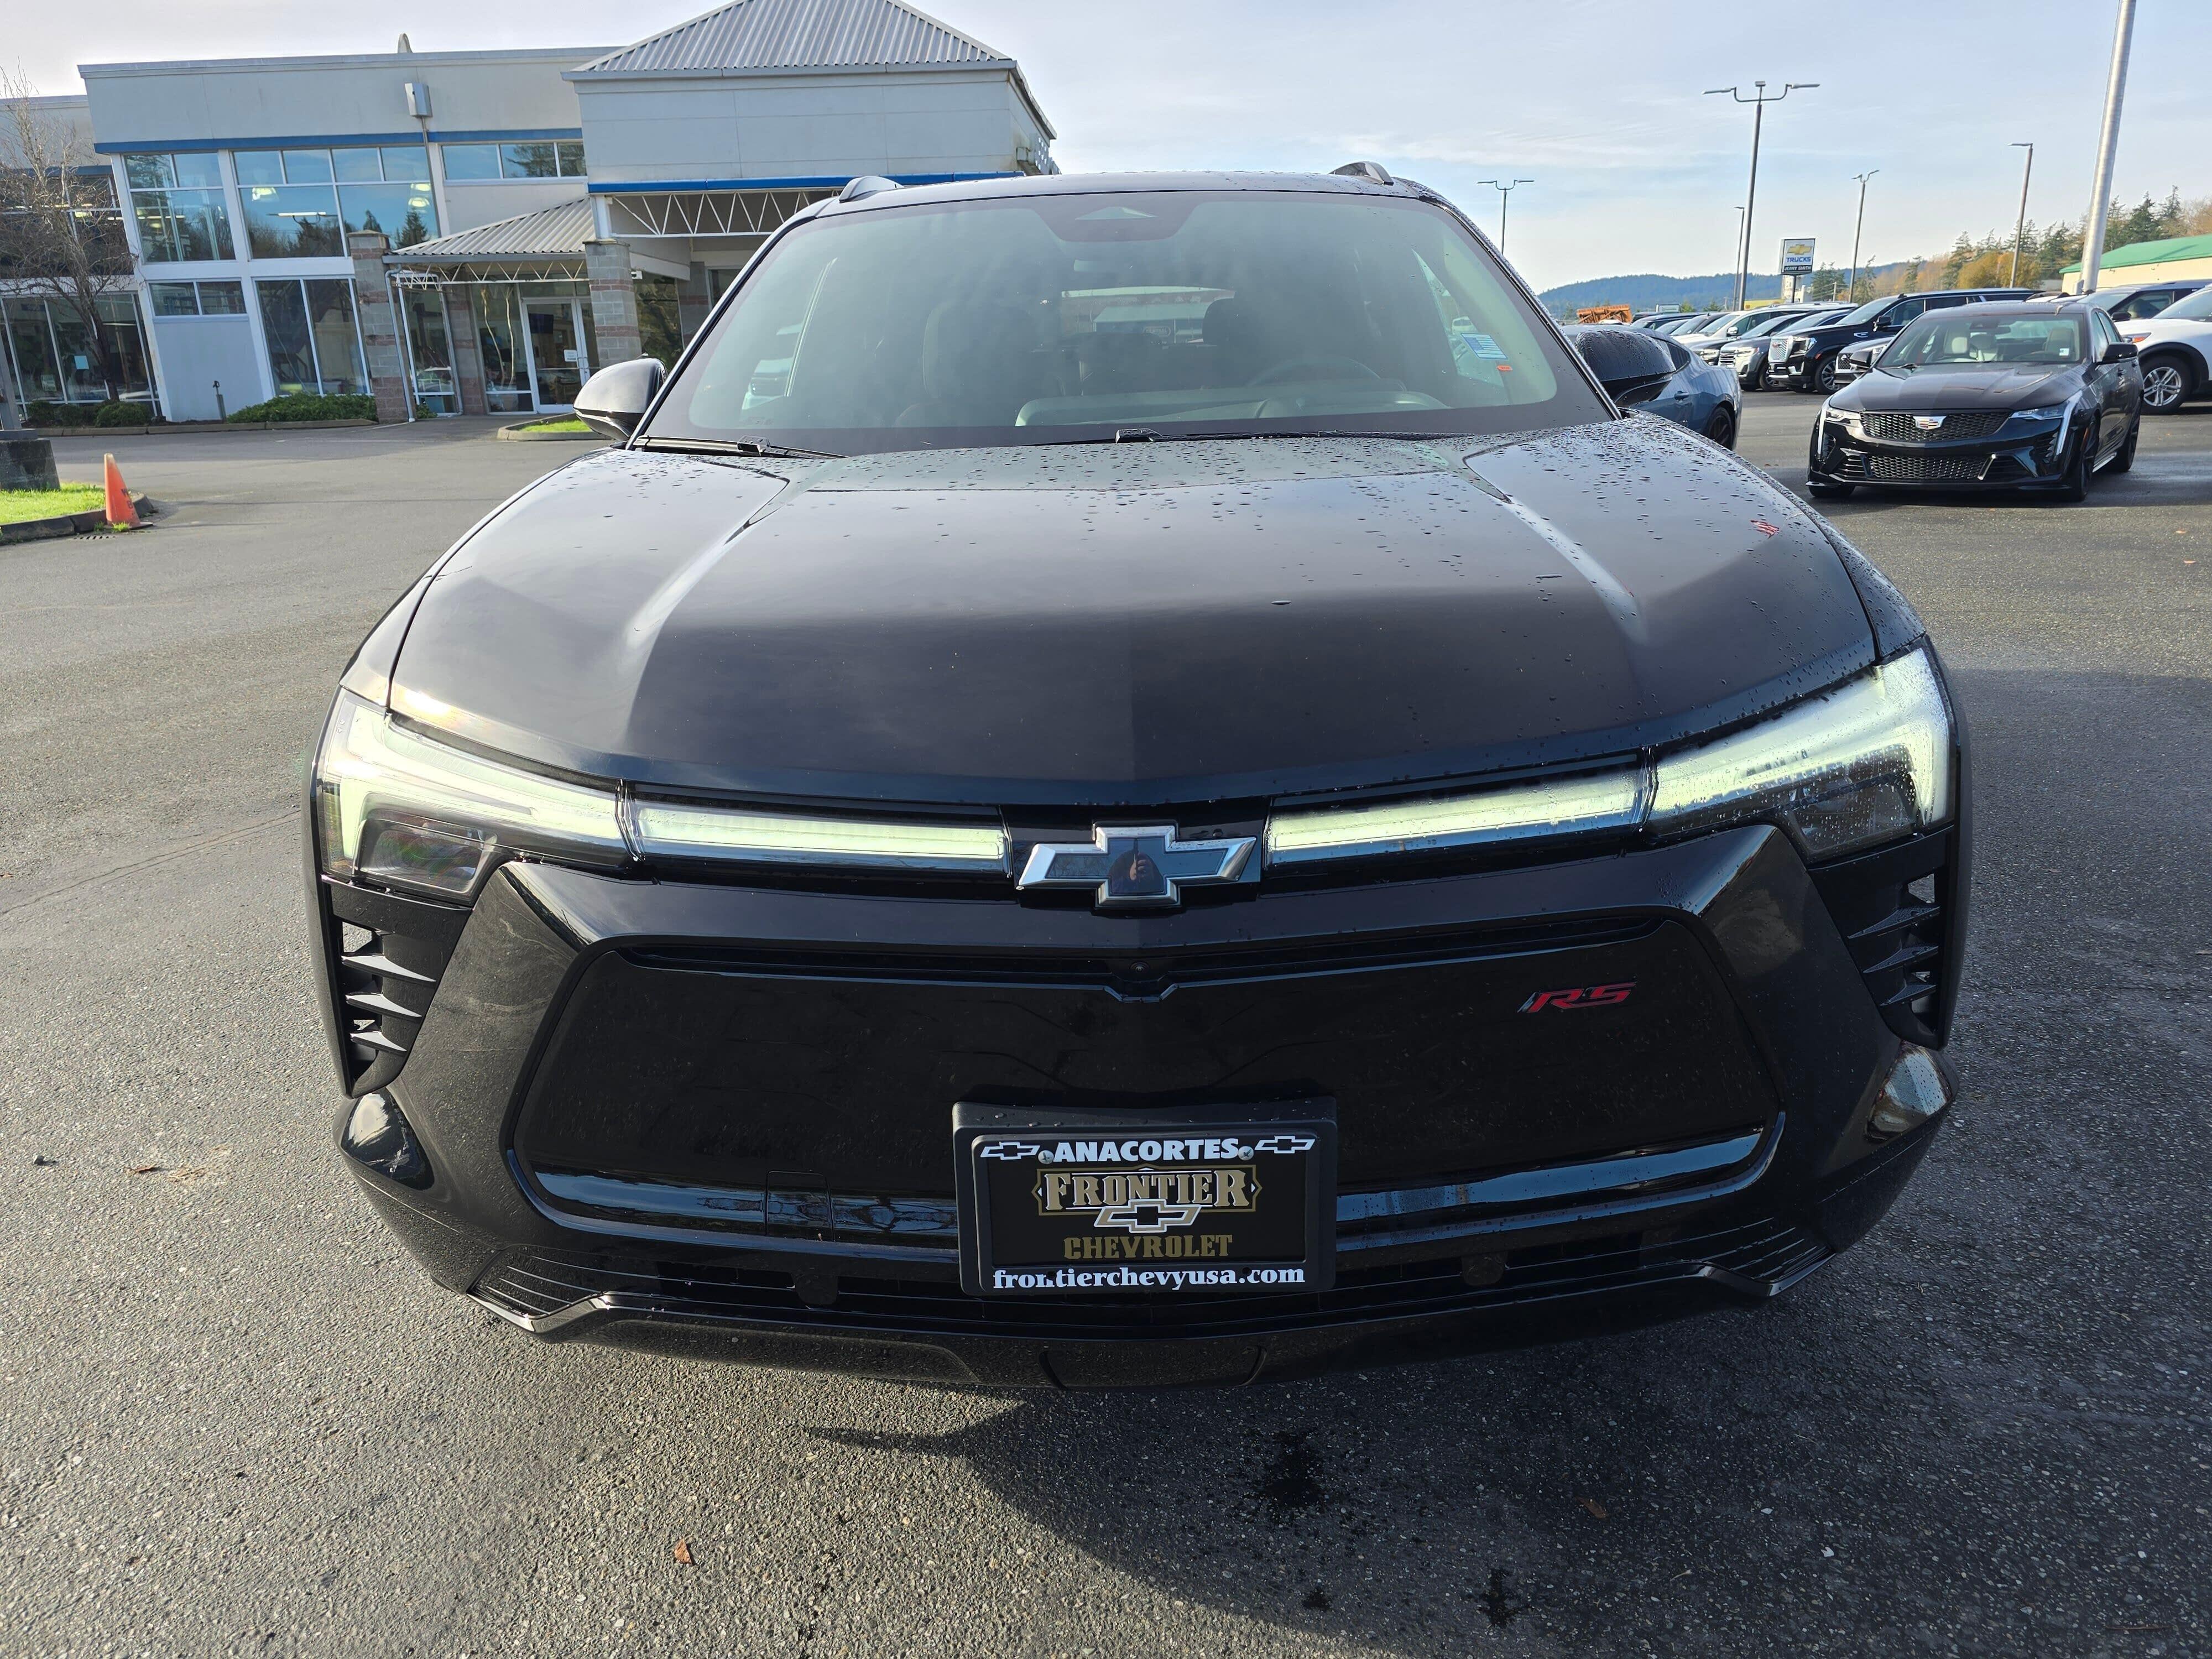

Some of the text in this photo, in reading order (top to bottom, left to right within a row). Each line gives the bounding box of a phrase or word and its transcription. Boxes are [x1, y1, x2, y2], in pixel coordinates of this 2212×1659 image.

[1526, 982, 1637, 1013] RS
[1053, 1138, 1239, 1162] ANACORTES
[1044, 1170, 1250, 1211] FRONTIER
[1063, 1234, 1233, 1259] CHEVROLET
[993, 1267, 1305, 1290] frontierchevyusa.com
